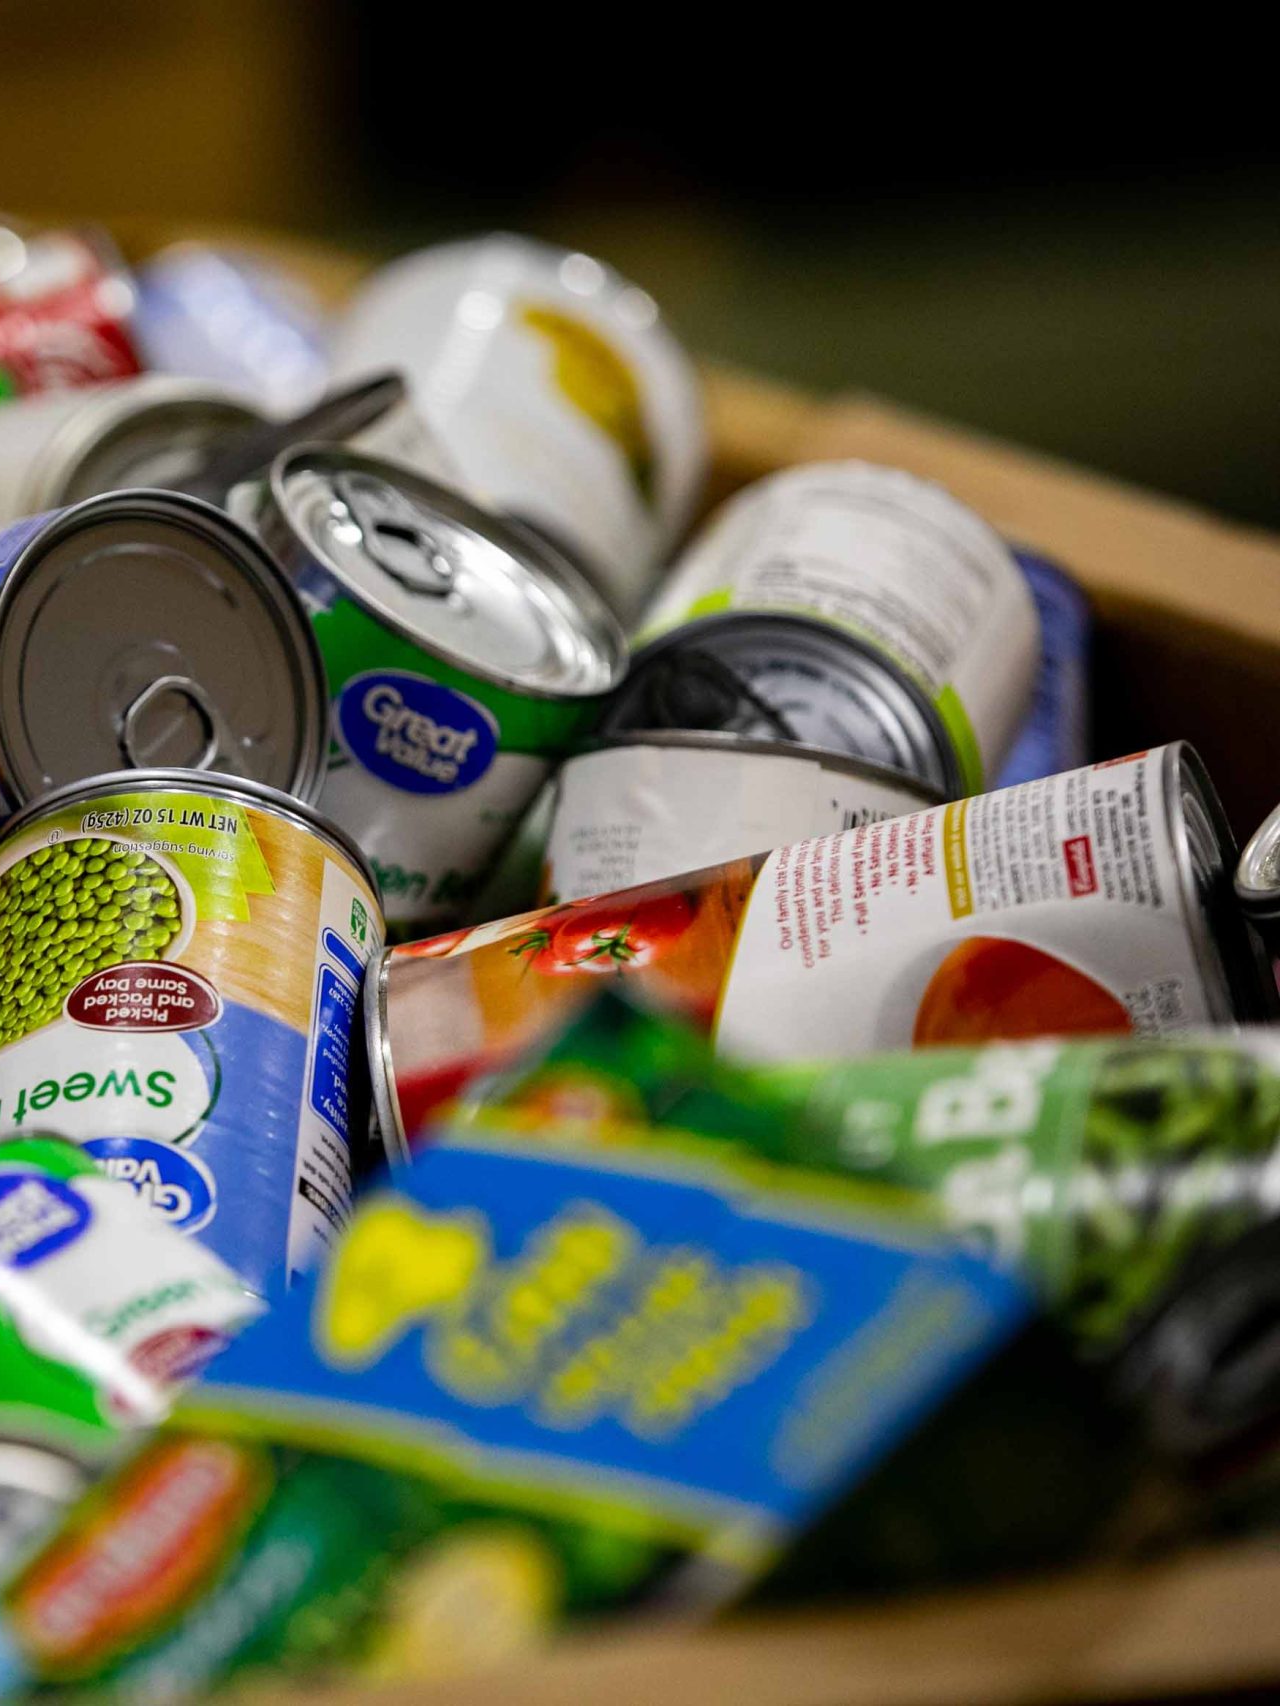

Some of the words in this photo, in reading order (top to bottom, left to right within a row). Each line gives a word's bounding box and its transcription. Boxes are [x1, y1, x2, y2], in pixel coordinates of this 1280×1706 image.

[363, 684, 471, 762] Great
[80, 808, 130, 835] (425g)
[132, 807, 154, 826] OZ
[158, 807, 175, 824] 15
[179, 808, 206, 828] WT
[208, 808, 239, 835] NET
[112, 840, 186, 854] suggestion
[904, 837, 917, 866] Added
[852, 860, 867, 899] Serving
[871, 871, 883, 888] No
[887, 861, 900, 878] No
[906, 870, 918, 887] No
[775, 889, 789, 923] family
[811, 886, 825, 908] and
[816, 910, 829, 935] you
[831, 898, 844, 925] This
[853, 901, 869, 925] Full
[780, 926, 793, 950] Our
[794, 899, 815, 968] condensed
[818, 938, 831, 959] for
[94, 977, 131, 992] Day
[134, 977, 188, 995] Same
[83, 992, 154, 1010] Packed
[157, 993, 196, 1009] and
[105, 1006, 169, 1022] Picked
[12, 1068, 177, 1126] Sweet
[319, 1094, 349, 1137] uality.
[96, 1157, 162, 1185] Val
